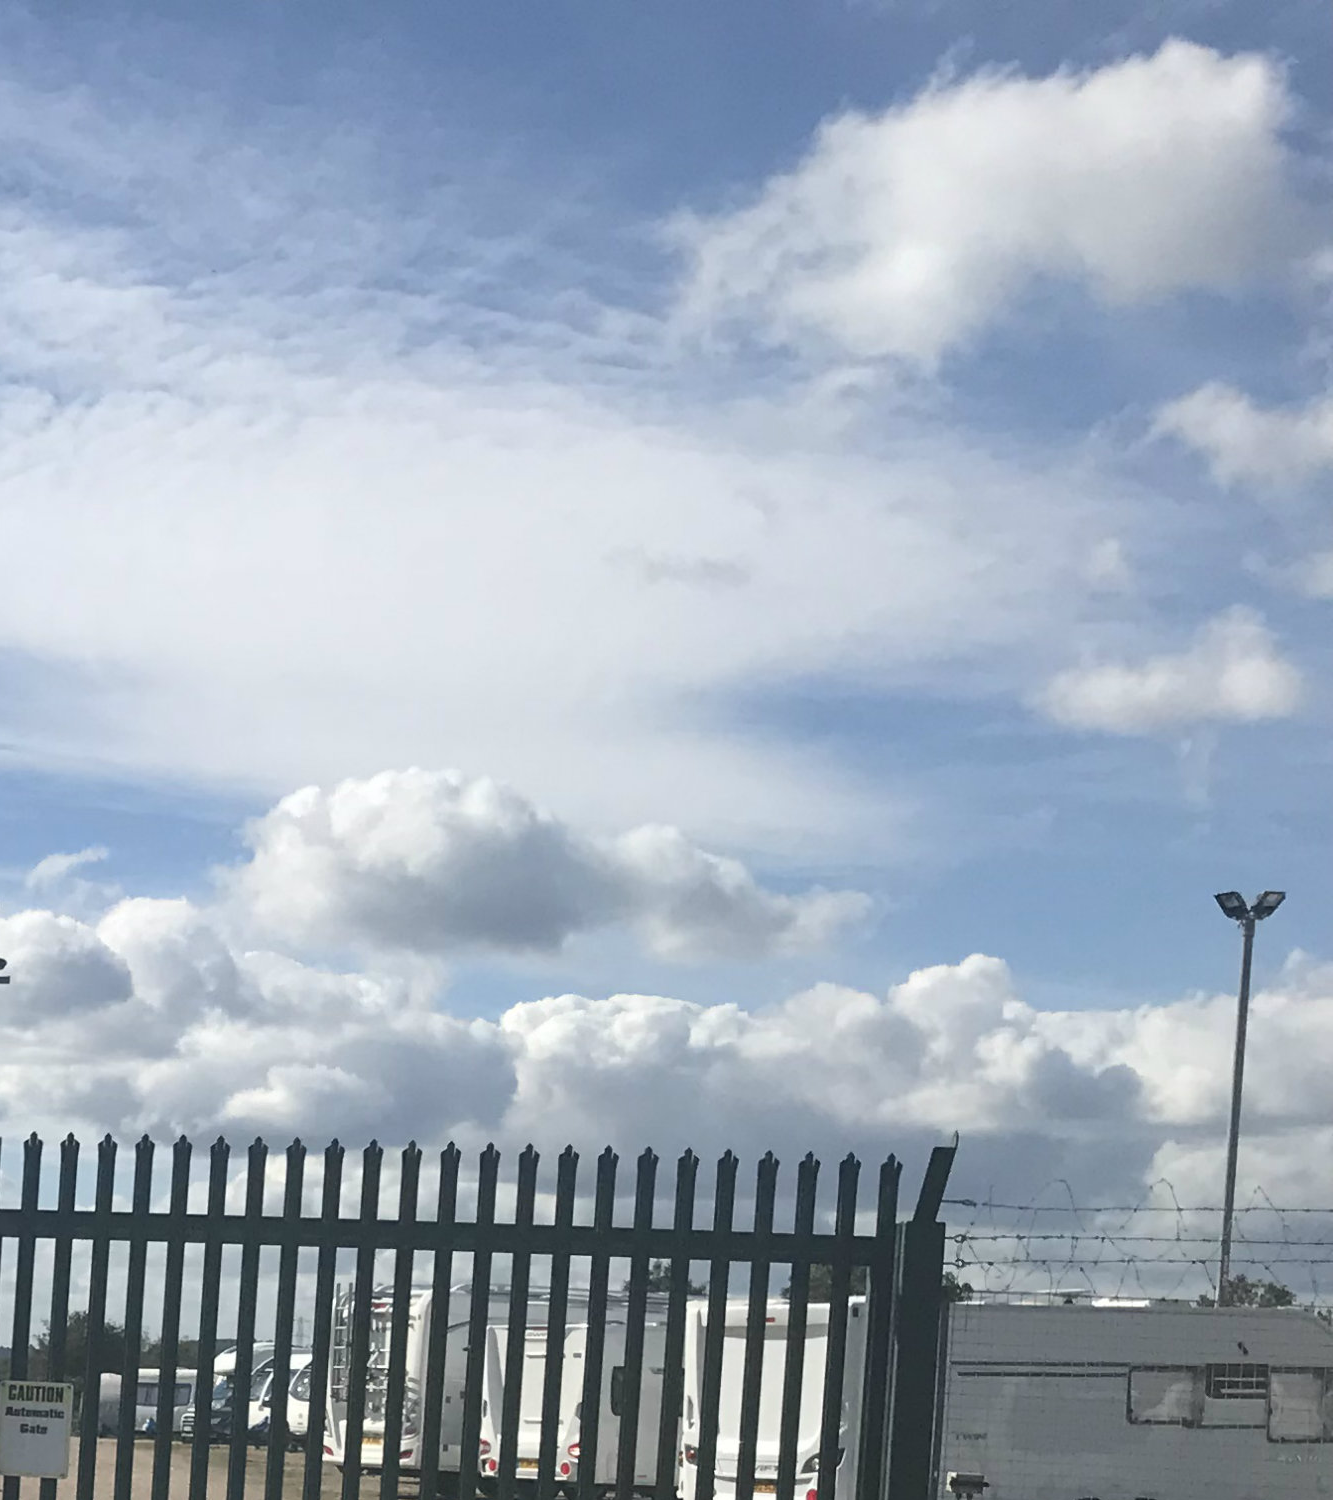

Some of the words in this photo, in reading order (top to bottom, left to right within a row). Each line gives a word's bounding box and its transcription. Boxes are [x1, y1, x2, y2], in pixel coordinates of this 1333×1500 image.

[8, 1384, 64, 1403] CAUTION
[5, 1406, 65, 1419] Automatic
[20, 1423, 48, 1434] Gate
